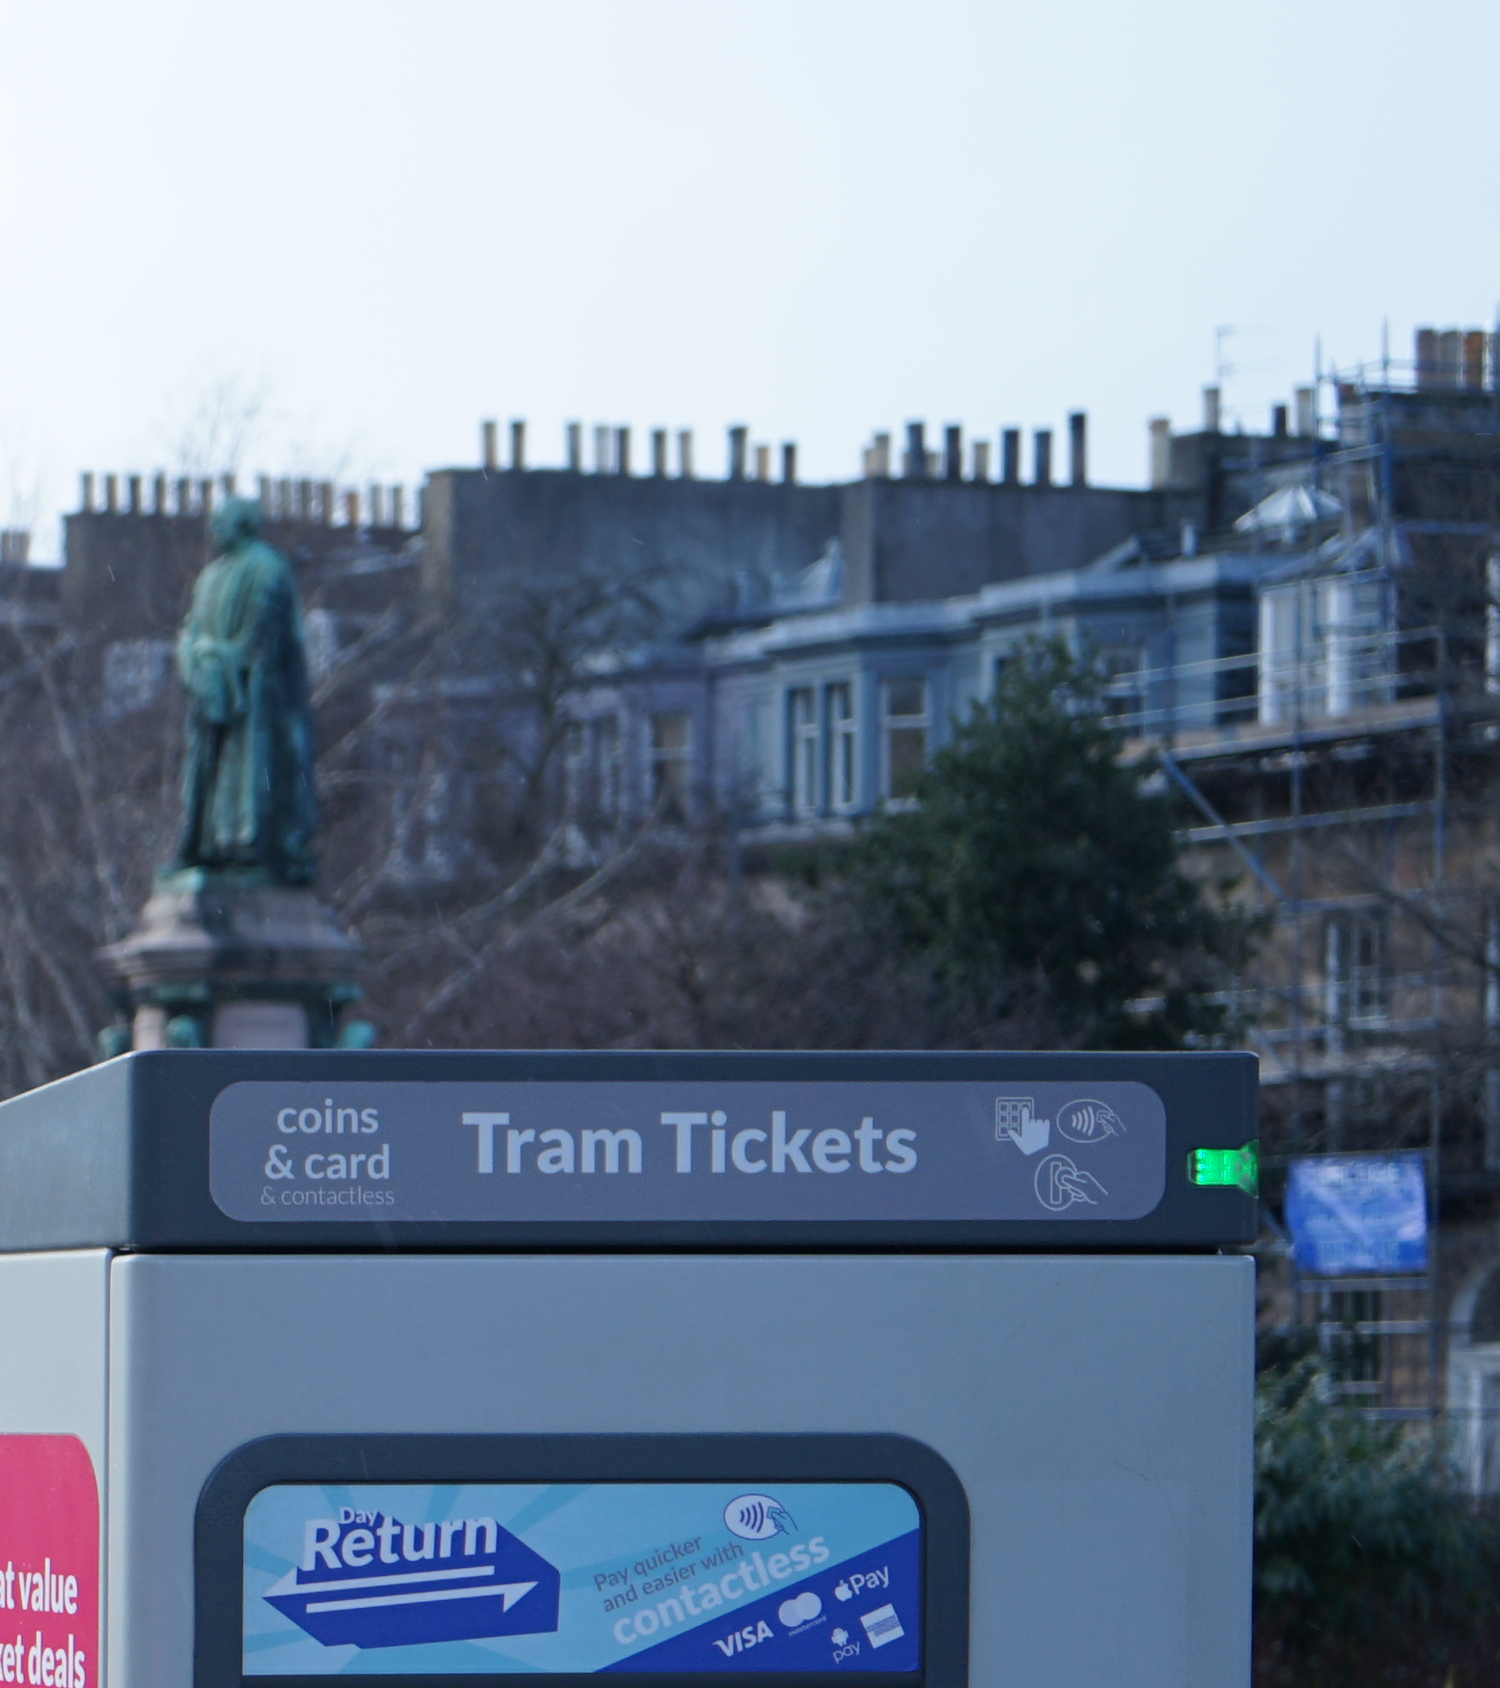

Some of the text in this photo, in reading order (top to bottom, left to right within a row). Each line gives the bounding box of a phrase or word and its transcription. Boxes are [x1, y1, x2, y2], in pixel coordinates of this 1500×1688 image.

[276, 1098, 379, 1135] coins
[462, 1110, 918, 1175] Tram Tickets
[263, 1143, 392, 1181] & card
[261, 1184, 395, 1207] & contactless
[338, 1507, 378, 1527] Day
[302, 1515, 498, 1572] Return
[593, 1537, 702, 1592] Pay quicker
[603, 1541, 743, 1612] and easier with
[850, 1565, 890, 1596] Pay
[18, 1557, 78, 1615] value
[613, 1536, 830, 1645] contactless
[712, 1620, 774, 1657] VISA
[832, 1641, 860, 1664] pay
